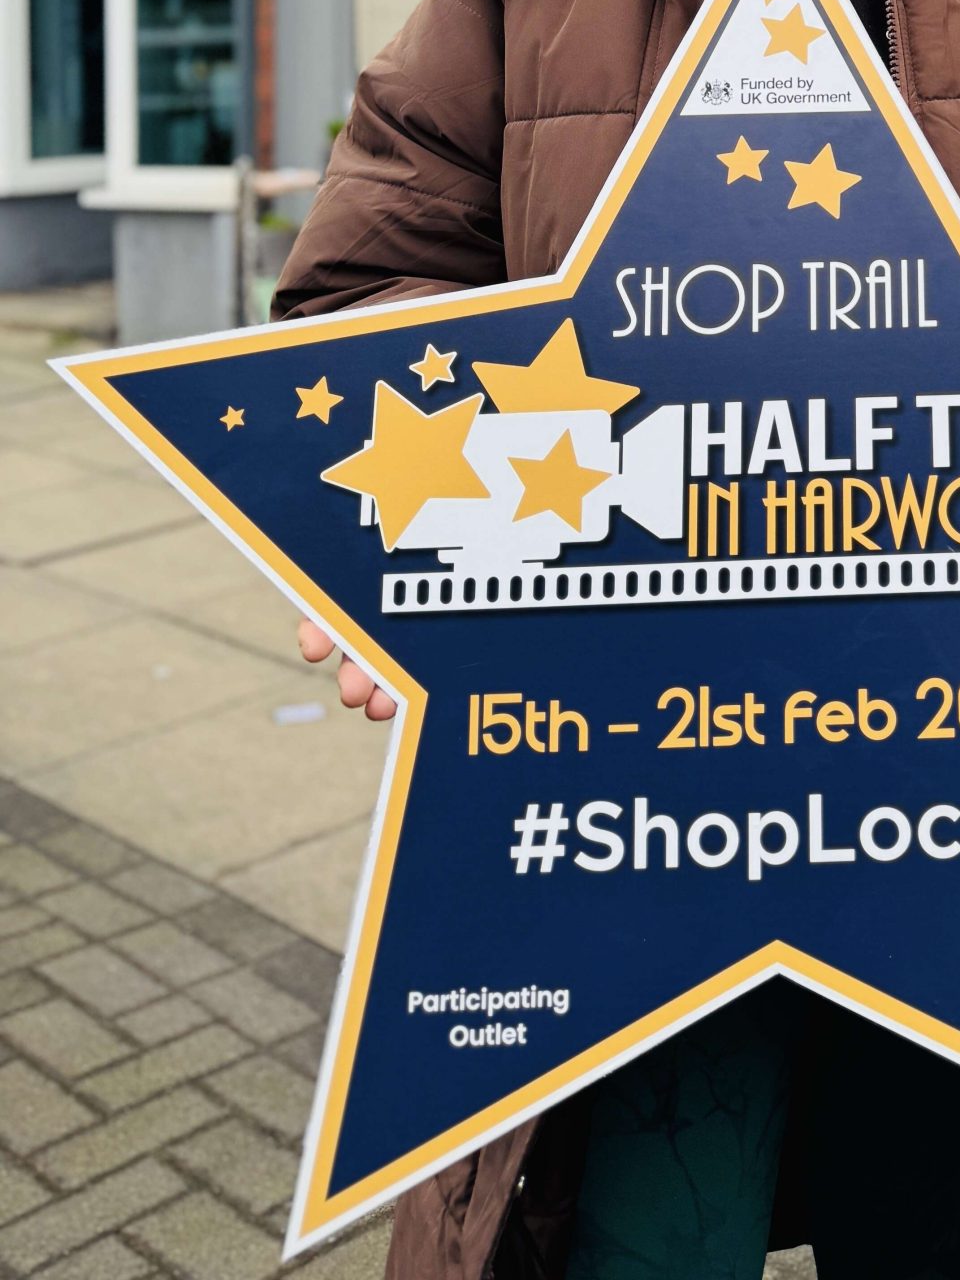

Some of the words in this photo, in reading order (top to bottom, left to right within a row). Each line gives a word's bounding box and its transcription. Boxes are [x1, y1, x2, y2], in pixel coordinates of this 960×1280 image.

[740, 77, 792, 90] Funded
[797, 77, 814, 91] by
[740, 93, 762, 105] UK
[766, 91, 852, 104] Government
[612, 263, 785, 338] SHOP
[802, 258, 938, 331] TRAIL
[690, 396, 899, 477] HALF
[688, 482, 739, 557] IN
[468, 692, 589, 756] 15th
[657, 685, 765, 749] 21st
[407, 984, 570, 1017] Participating
[449, 1022, 527, 1048] Outlet
